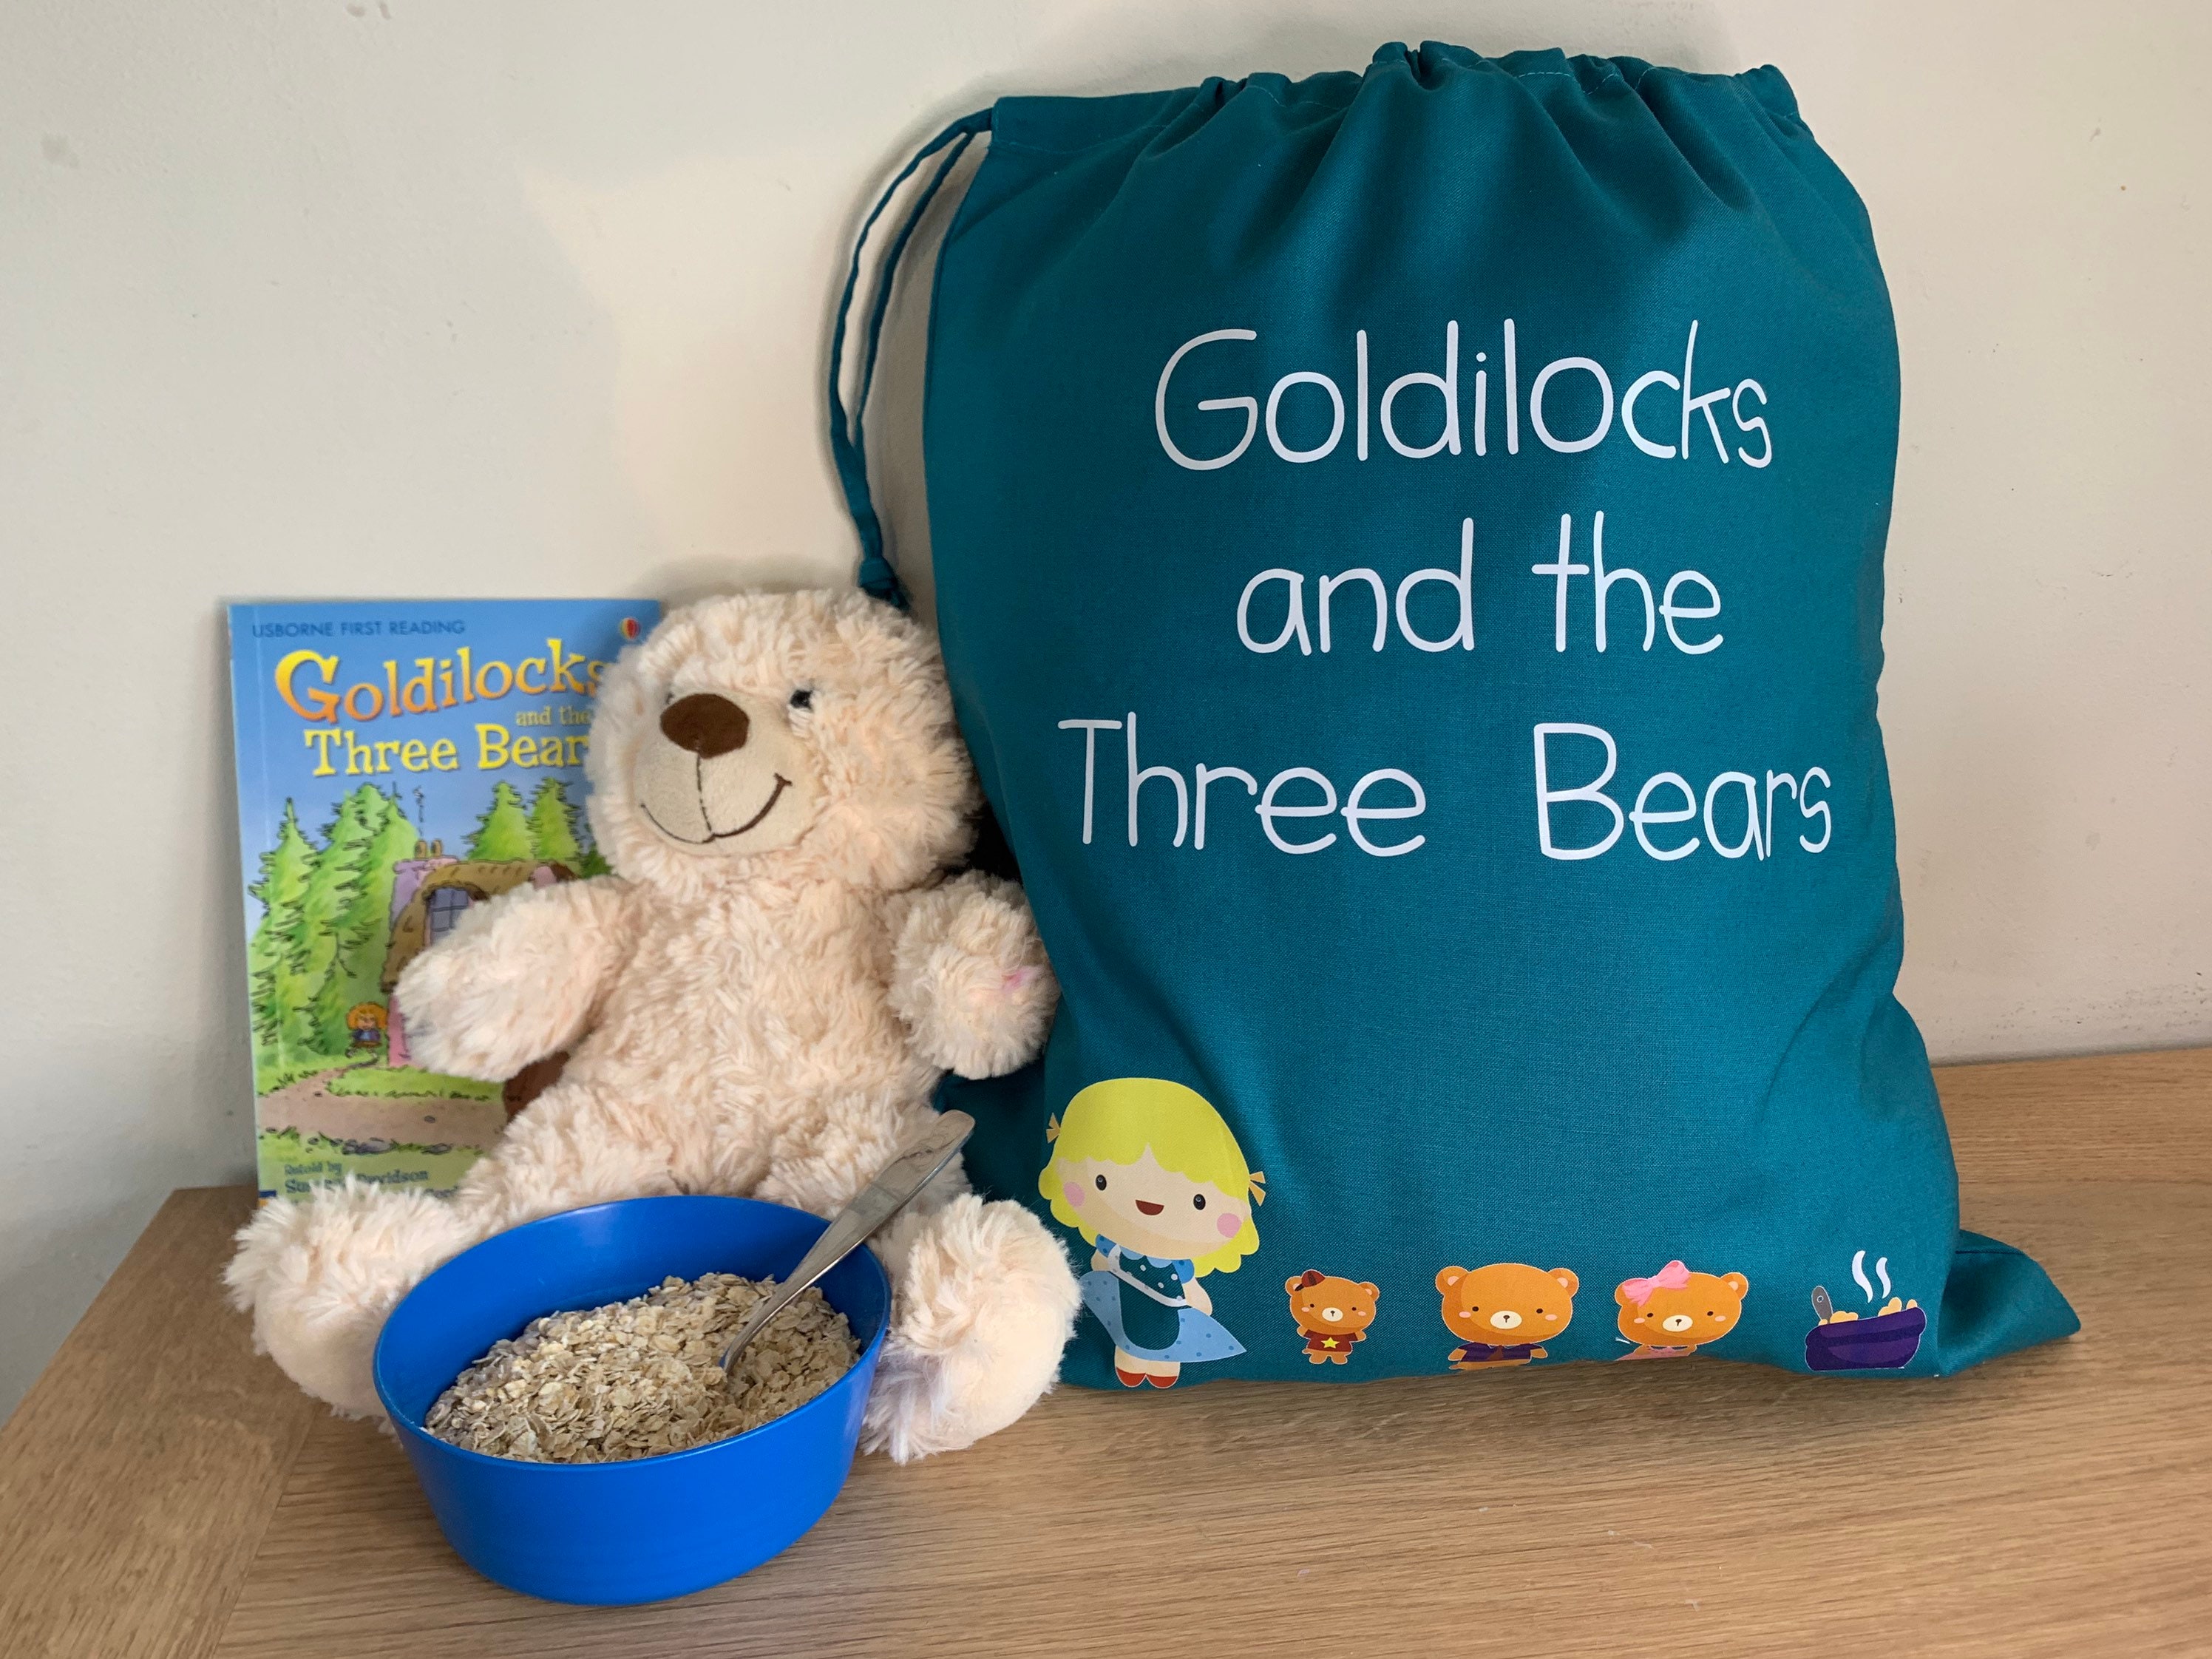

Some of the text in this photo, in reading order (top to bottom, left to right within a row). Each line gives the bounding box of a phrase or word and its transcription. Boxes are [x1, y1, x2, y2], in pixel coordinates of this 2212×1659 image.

[1155, 318, 1773, 471] Goldilocks
[252, 619, 466, 638] USBORNE FIRST READING
[1237, 510, 1724, 656] and the
[304, 723, 590, 776] Three Bear
[516, 705, 552, 727] and
[1057, 711, 1832, 861] Three Bears
